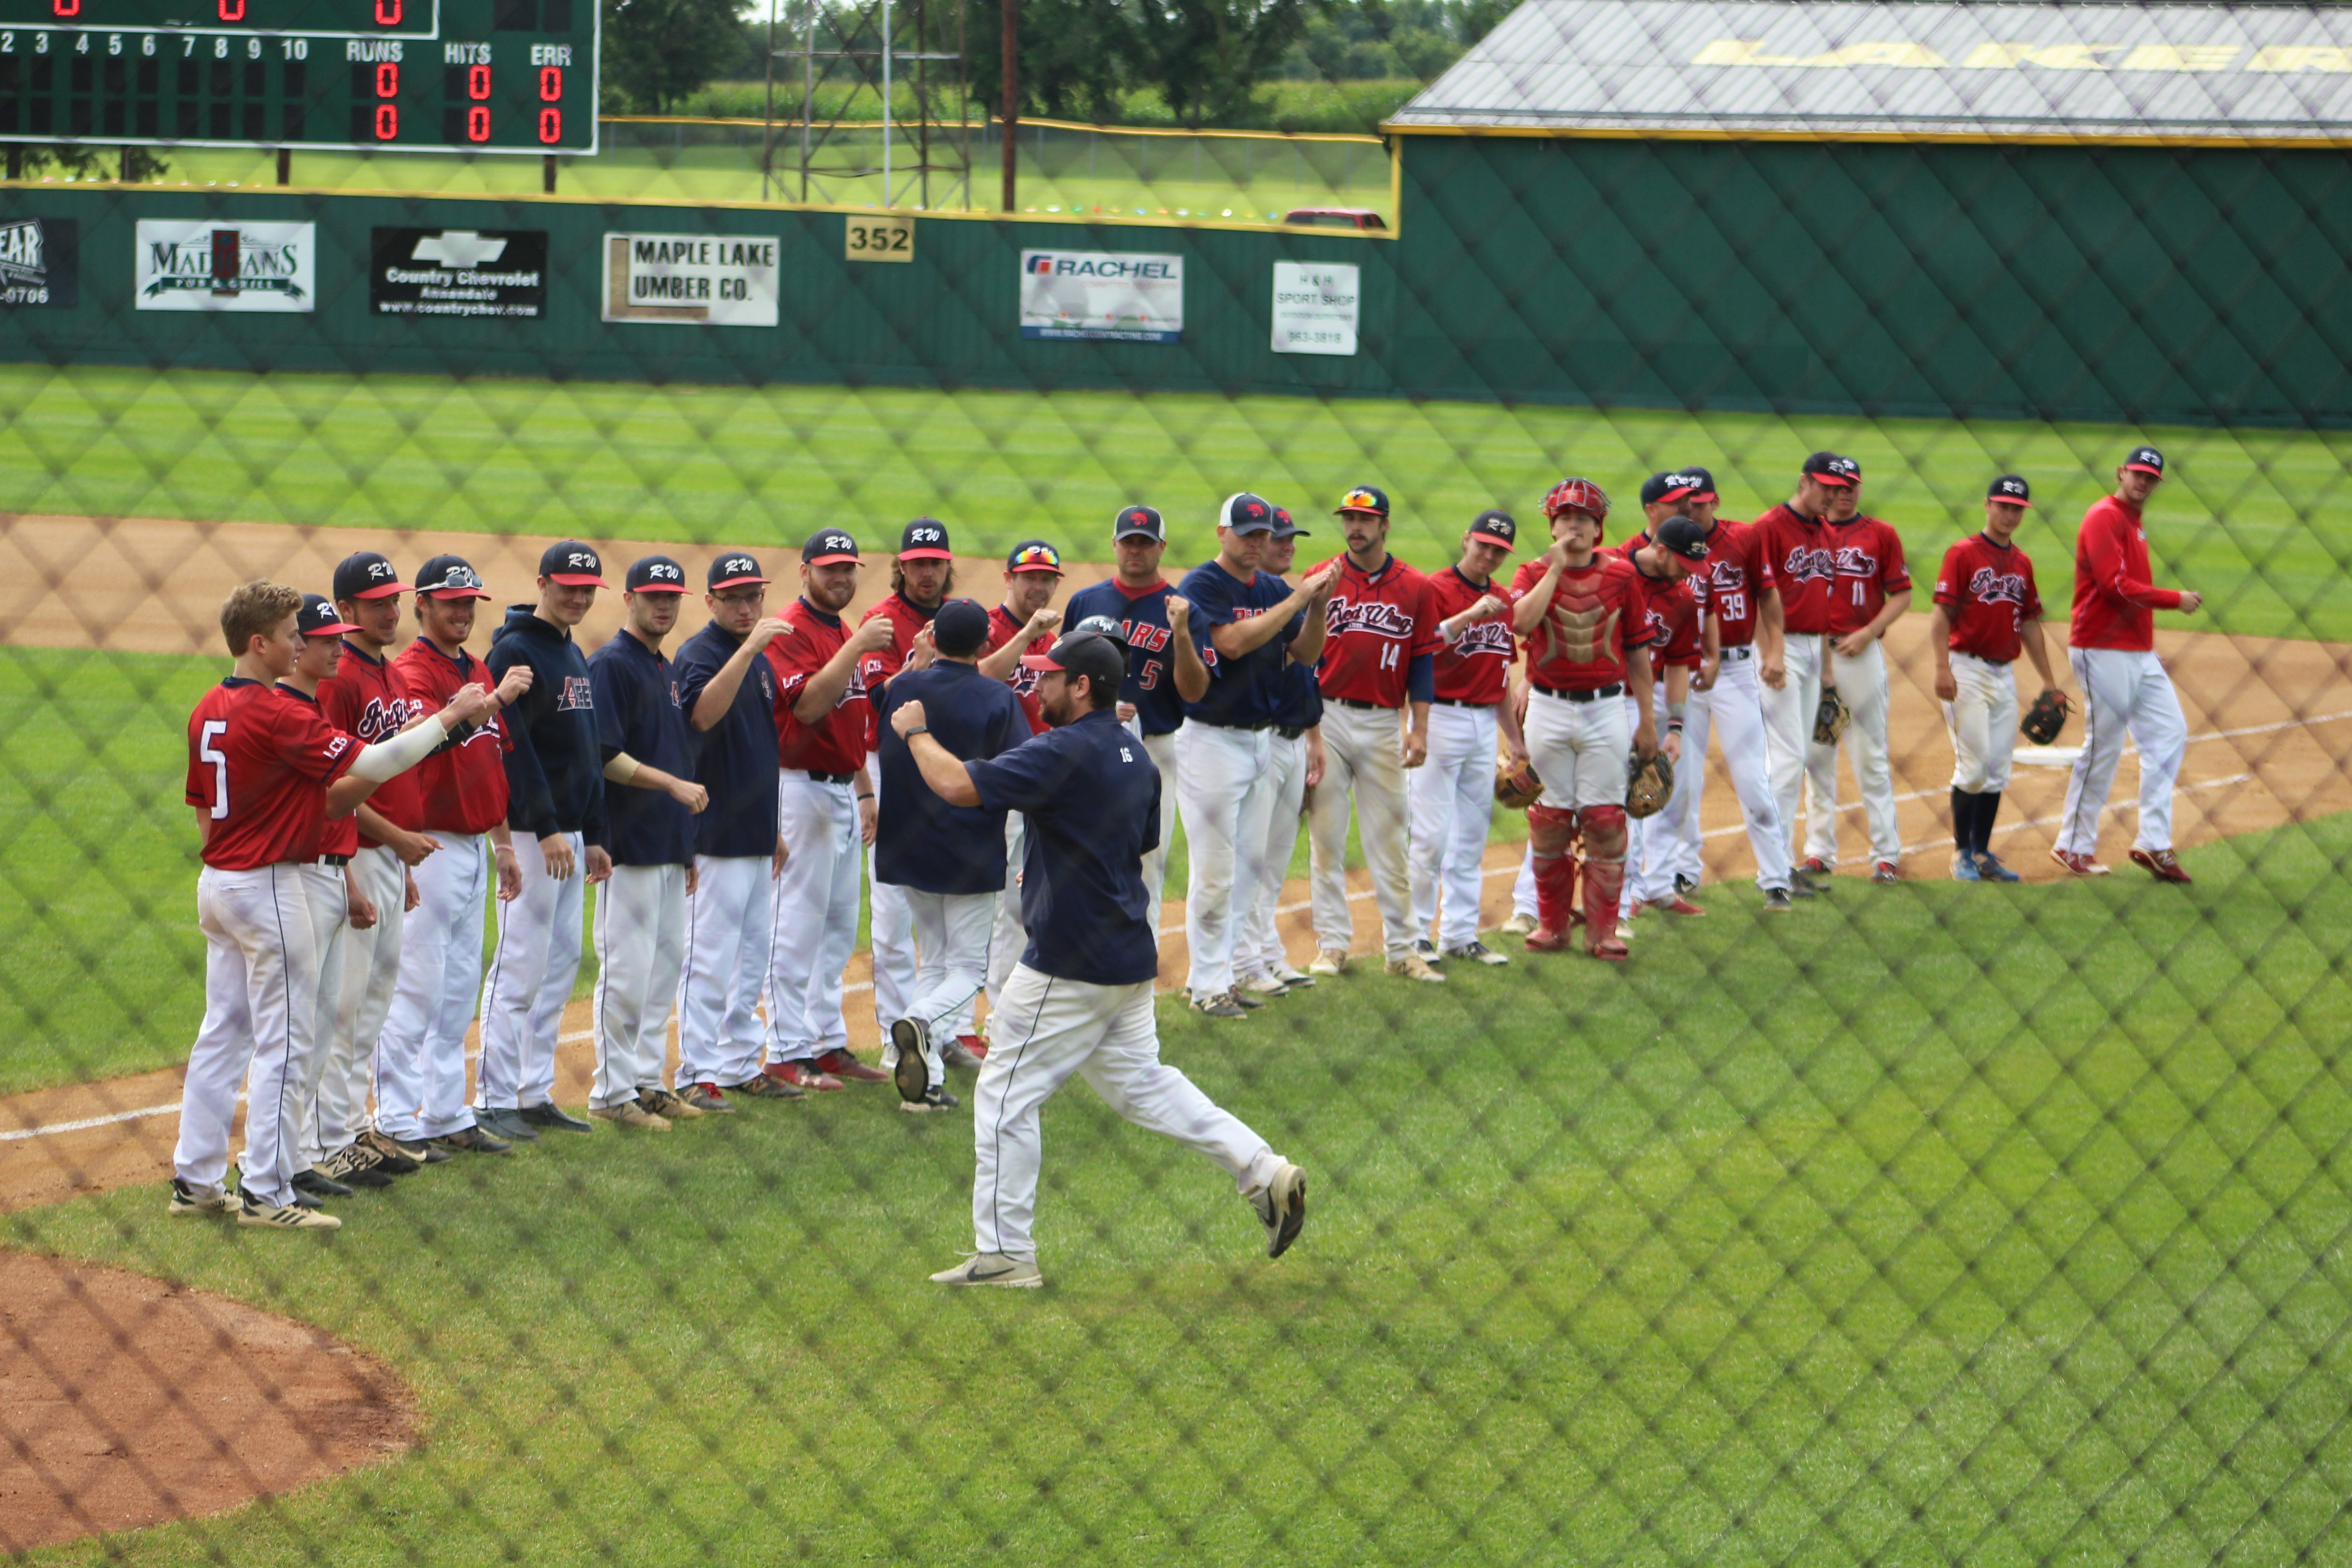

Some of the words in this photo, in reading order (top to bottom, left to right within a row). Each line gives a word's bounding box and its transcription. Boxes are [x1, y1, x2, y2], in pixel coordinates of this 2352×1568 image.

[1, 31, 14, 53] 2
[35, 32, 48, 54] 3
[75, 33, 89, 54] 4
[109, 34, 122, 55] 5
[142, 35, 156, 56] 6
[183, 36, 196, 57] 7
[215, 37, 228, 59] 8
[247, 38, 262, 59] 9
[281, 39, 308, 60] 10
[346, 39, 403, 63] RUNS
[444, 41, 491, 64] HITS
[530, 44, 572, 66] ERR
[376, 63, 397, 97] 0
[469, 64, 490, 99] 0
[539, 66, 561, 101] 0
[375, 104, 397, 139] 0
[468, 106, 490, 141] 0
[539, 107, 561, 143] 0
[850, 227, 909, 251] 352
[635, 241, 710, 265] MAPLE
[719, 243, 775, 267] LAKE
[386, 267, 454, 287] Country
[456, 268, 540, 287] Chevrolet
[1056, 260, 1177, 279] RACHEL
[420, 284, 498, 301] Annandale
[719, 278, 753, 301] CO.
[1277, 293, 1318, 304] SPORT
[1321, 295, 1355, 306] SHOP
[379, 300, 539, 316] www.countrychev.com
[825, 535, 853, 550] RW
[911, 528, 940, 544] RW
[568, 553, 597, 569] RW
[650, 564, 679, 579] RW
[725, 558, 753, 575] RW
[1721, 593, 1746, 622] 39
[1122, 619, 1172, 652] ARS
[864, 659, 882, 676] LCG
[1380, 642, 1401, 672] 14
[1139, 659, 1163, 691] 5
[323, 736, 348, 760] LCG
[1119, 747, 1133, 763] 16
[200, 719, 229, 820] 5
